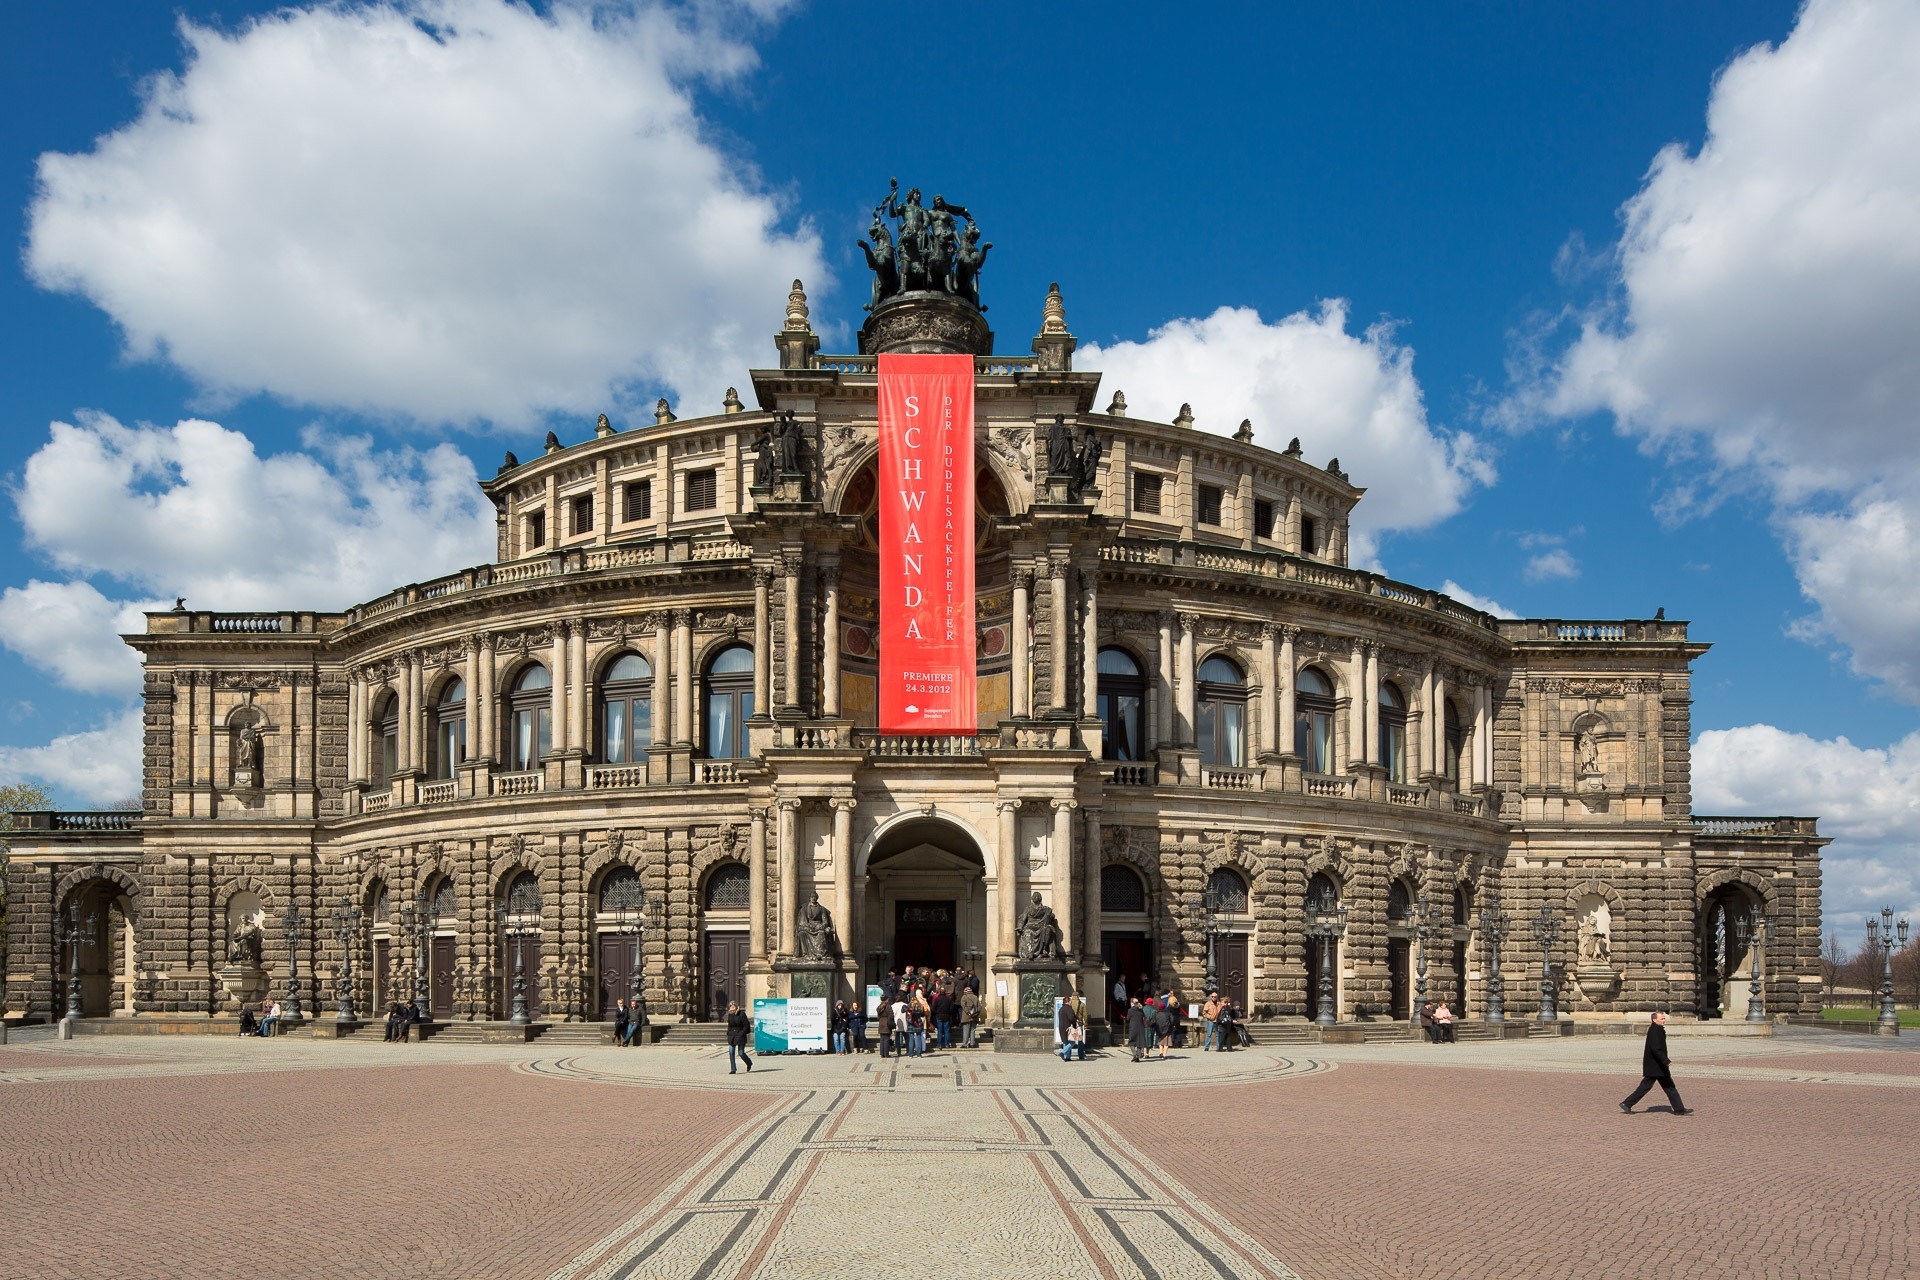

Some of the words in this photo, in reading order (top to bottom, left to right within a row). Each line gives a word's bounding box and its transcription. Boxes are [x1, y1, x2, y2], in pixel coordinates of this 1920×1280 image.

[944, 396, 953, 431] DER
[899, 396, 926, 640] SCHWANDA
[944, 445, 954, 641] DUDELSACKPFEIFER
[903, 672, 952, 682] PREMIERE
[905, 684, 950, 693] 24.3.2012
